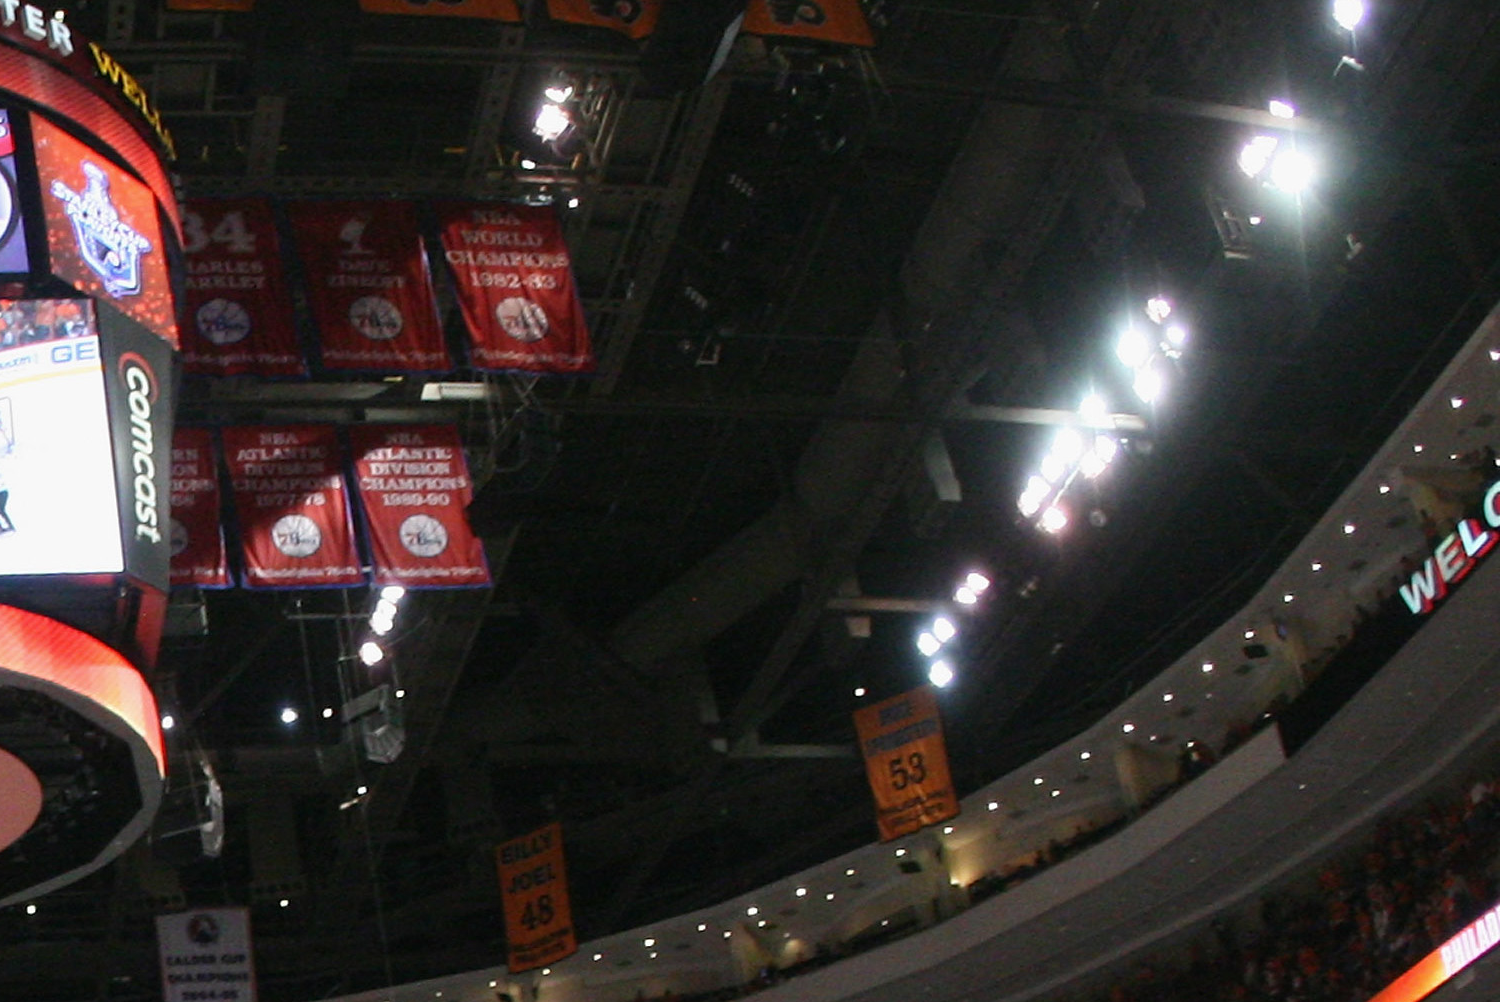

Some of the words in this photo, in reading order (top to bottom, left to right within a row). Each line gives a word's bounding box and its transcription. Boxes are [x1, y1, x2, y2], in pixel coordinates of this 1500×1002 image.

[363, 447, 453, 461] ATLANTIC
[370, 462, 451, 476] DIVISION
[359, 476, 468, 491] CHAMPIONS
[891, 753, 925, 790] 53
